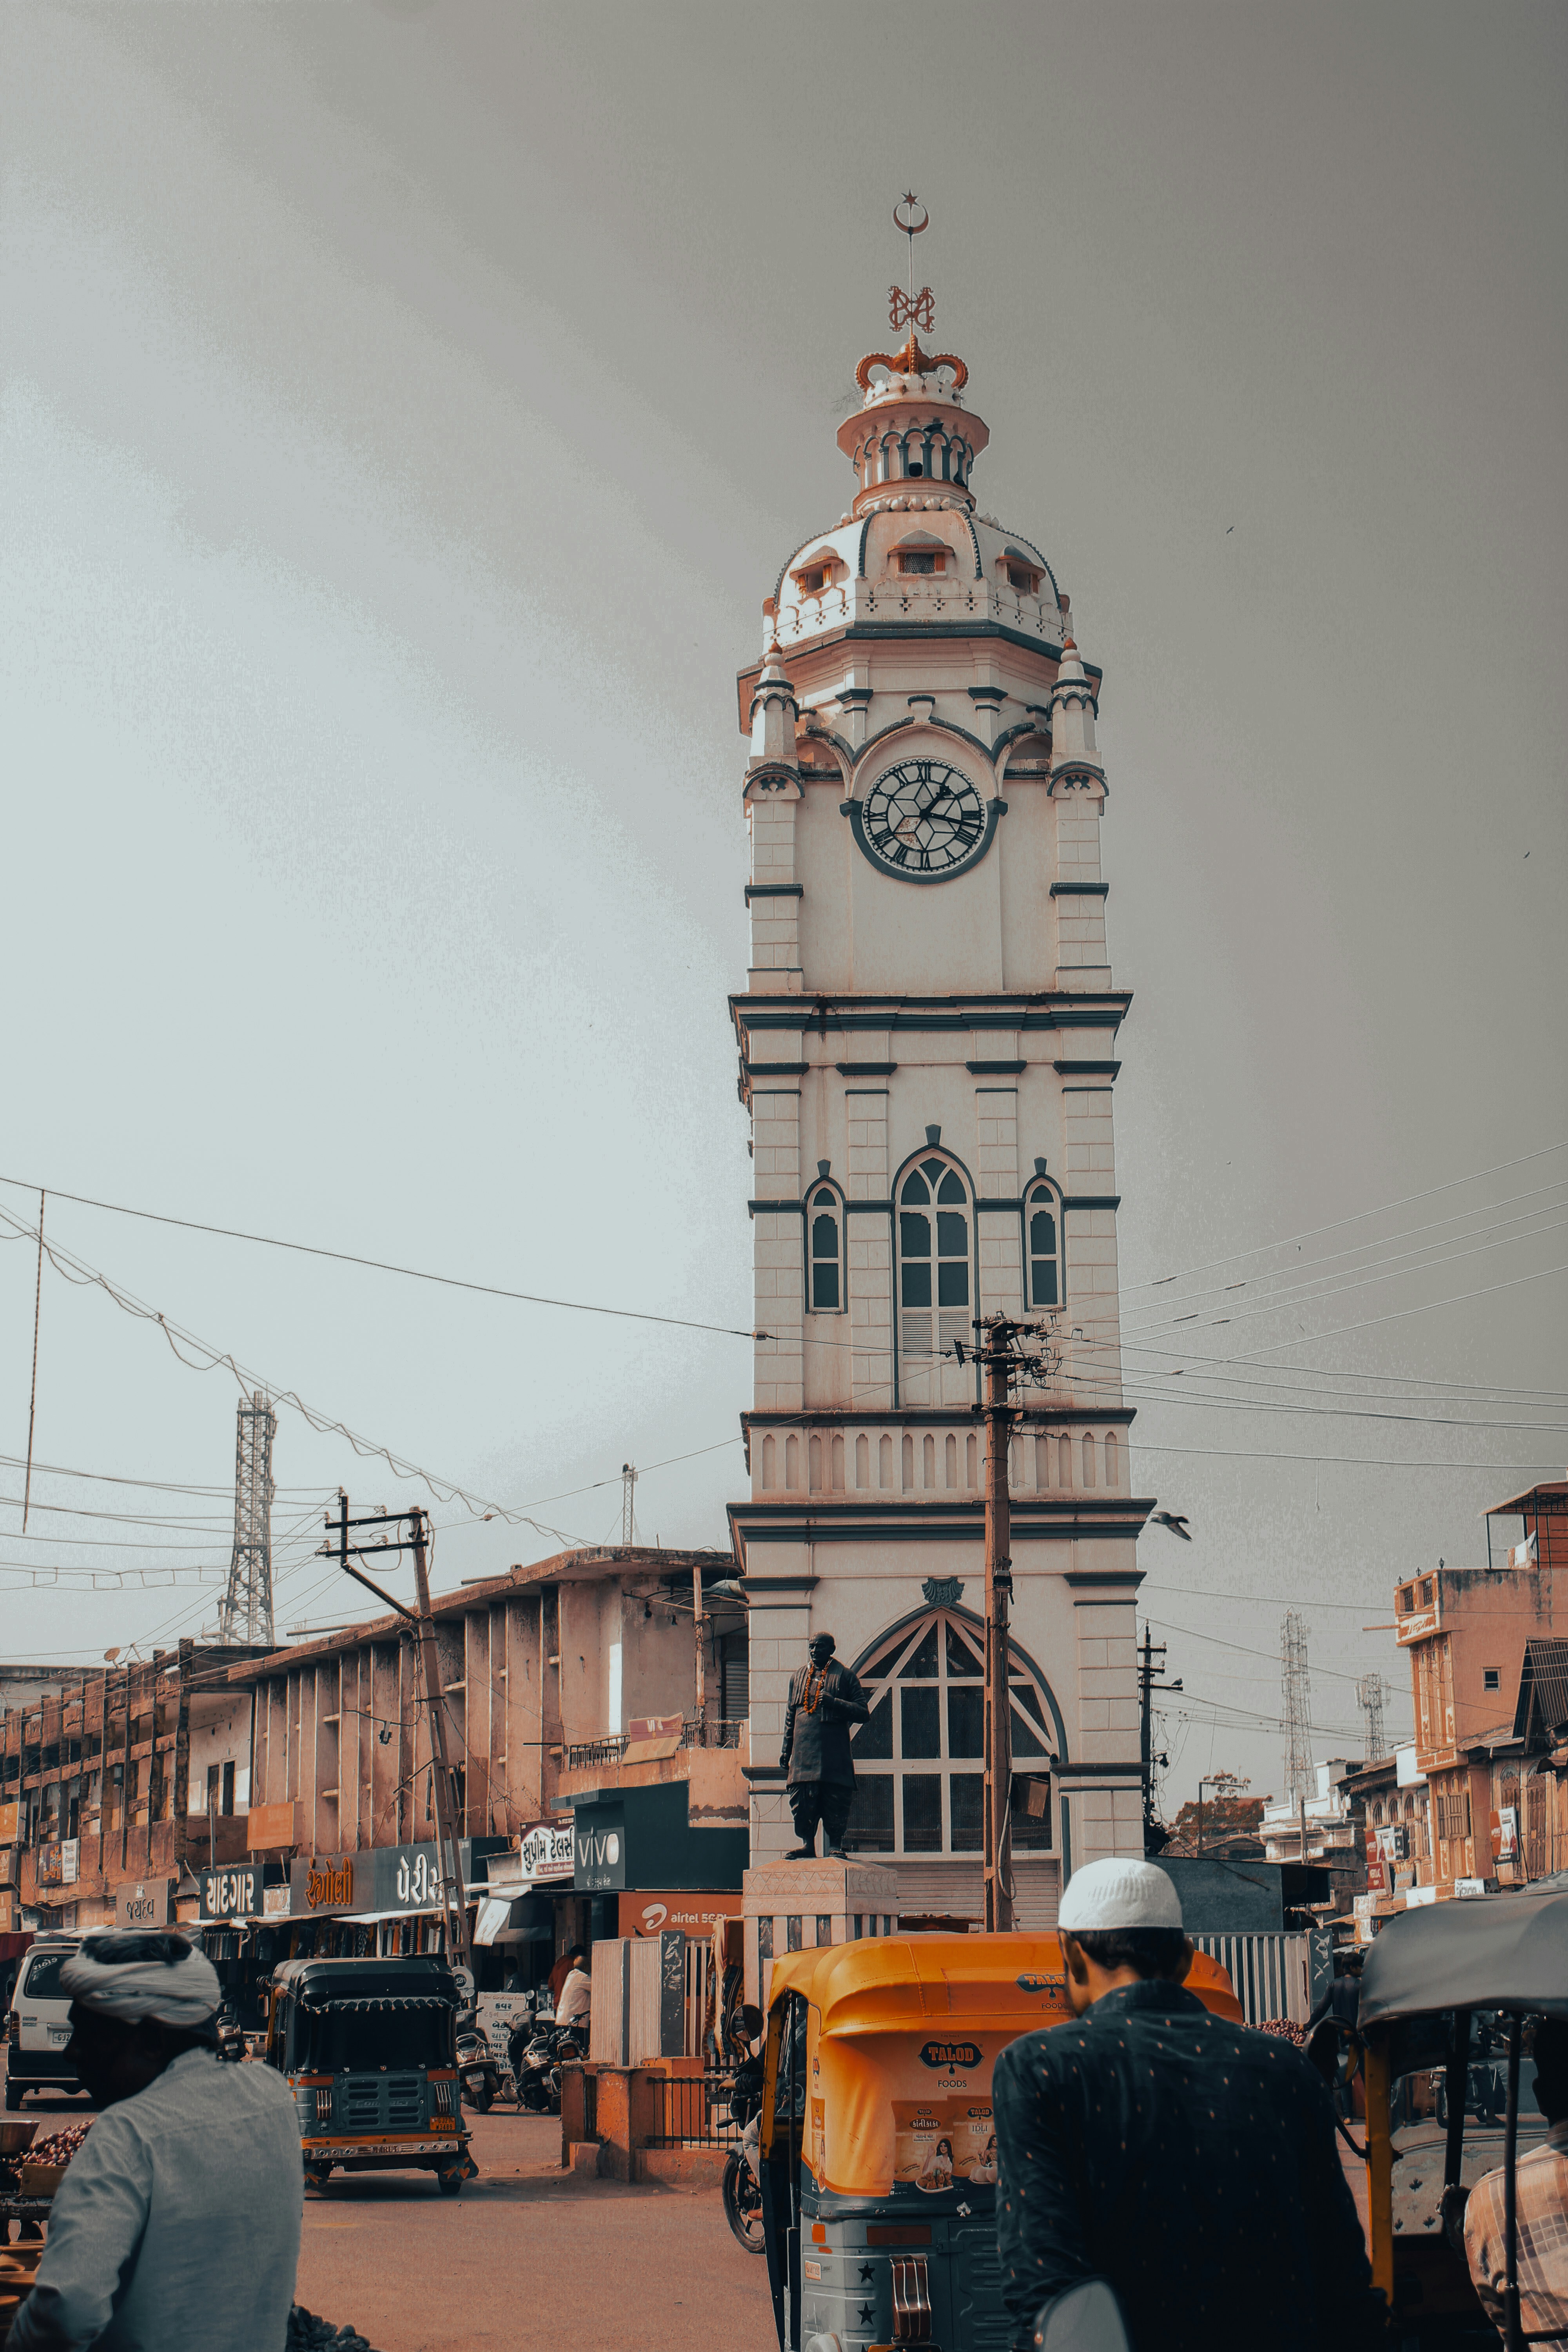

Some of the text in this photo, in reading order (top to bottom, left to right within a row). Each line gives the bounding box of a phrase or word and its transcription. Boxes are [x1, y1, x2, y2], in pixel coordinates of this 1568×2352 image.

[578, 1826, 619, 1867] vivo
[206, 1873, 254, 1915] યાદગાર
[305, 1857, 352, 1909] રંગોલી
[671, 1911, 699, 1924] airtel
[1024, 1976, 1066, 1985] TALO
[928, 2047, 974, 2062] TALOD
